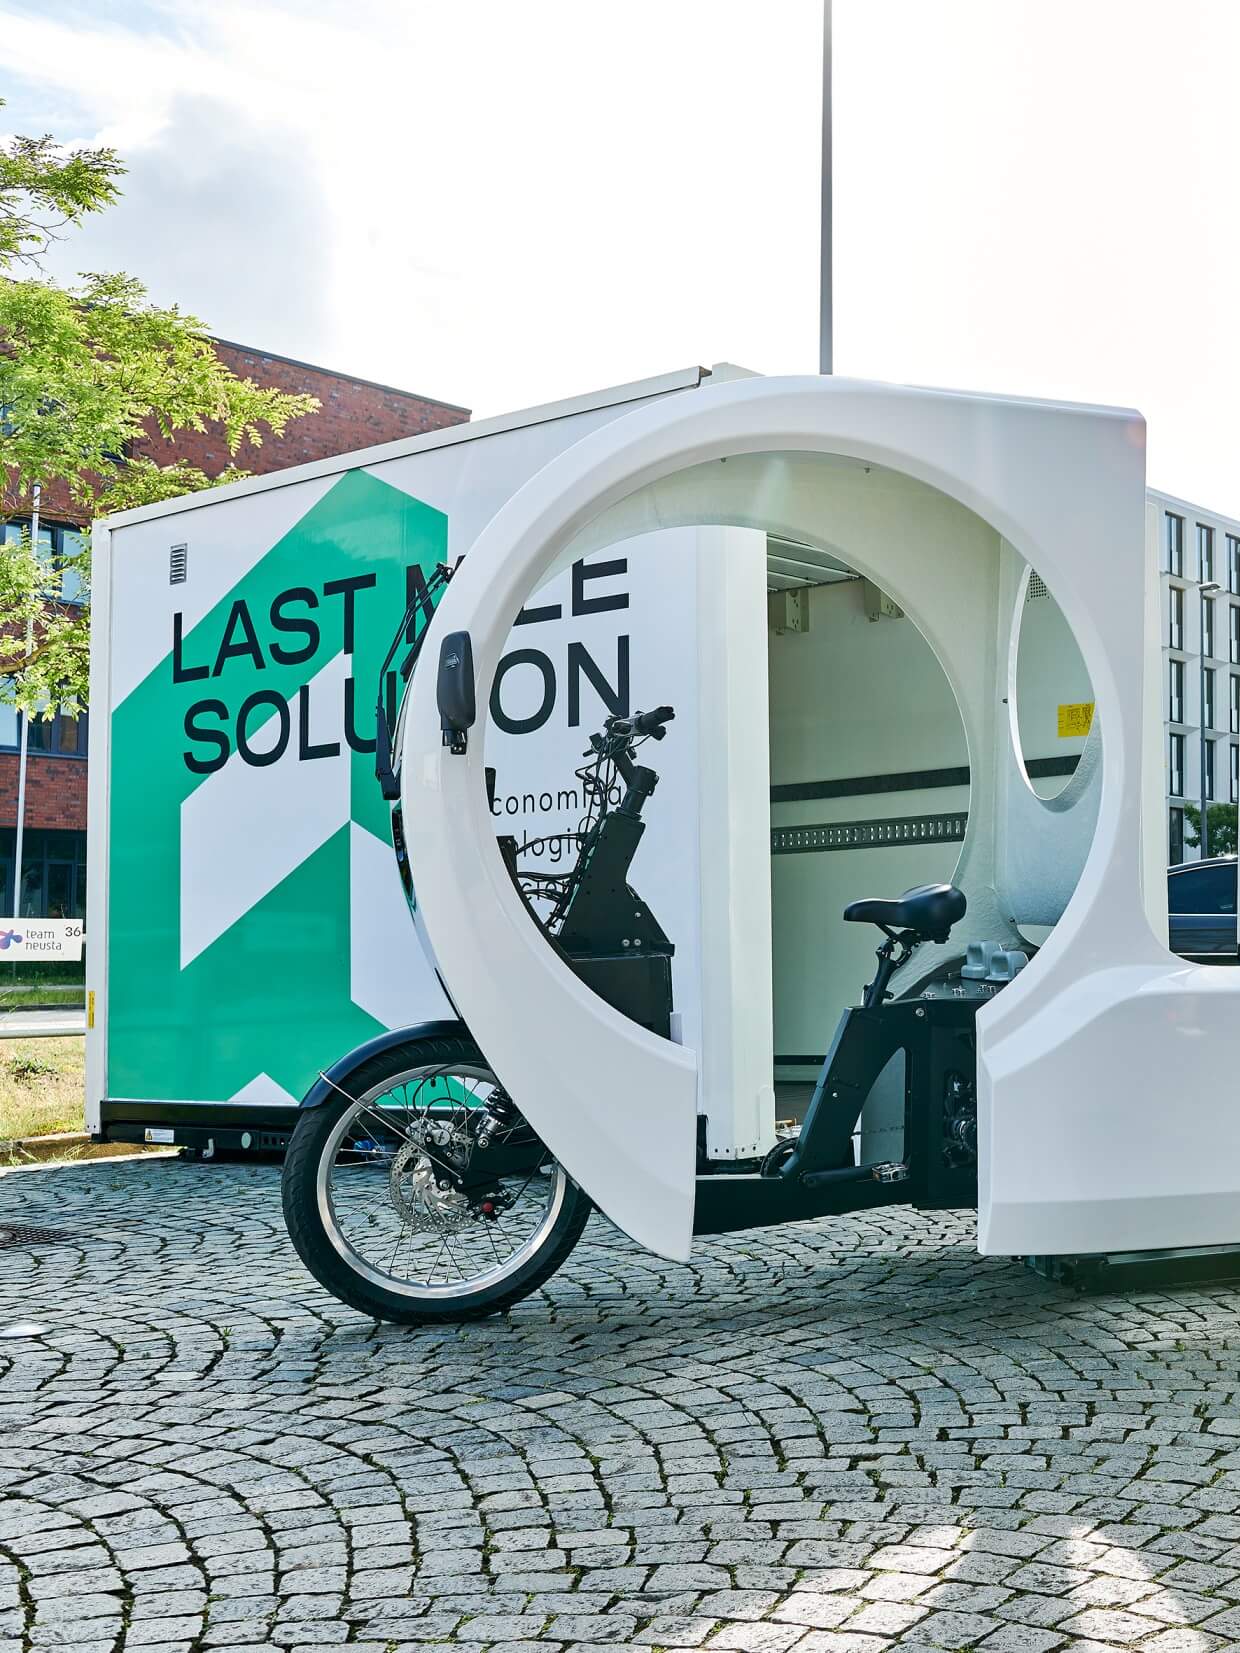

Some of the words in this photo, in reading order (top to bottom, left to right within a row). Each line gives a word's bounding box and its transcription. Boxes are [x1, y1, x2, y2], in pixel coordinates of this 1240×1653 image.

[172, 573, 376, 684] LAST
[405, 555, 630, 645] ME
[183, 635, 630, 775] SOLUON
[26, 928, 55, 939] team
[65, 926, 81, 937] 36
[25, 941, 62, 950] neusta
